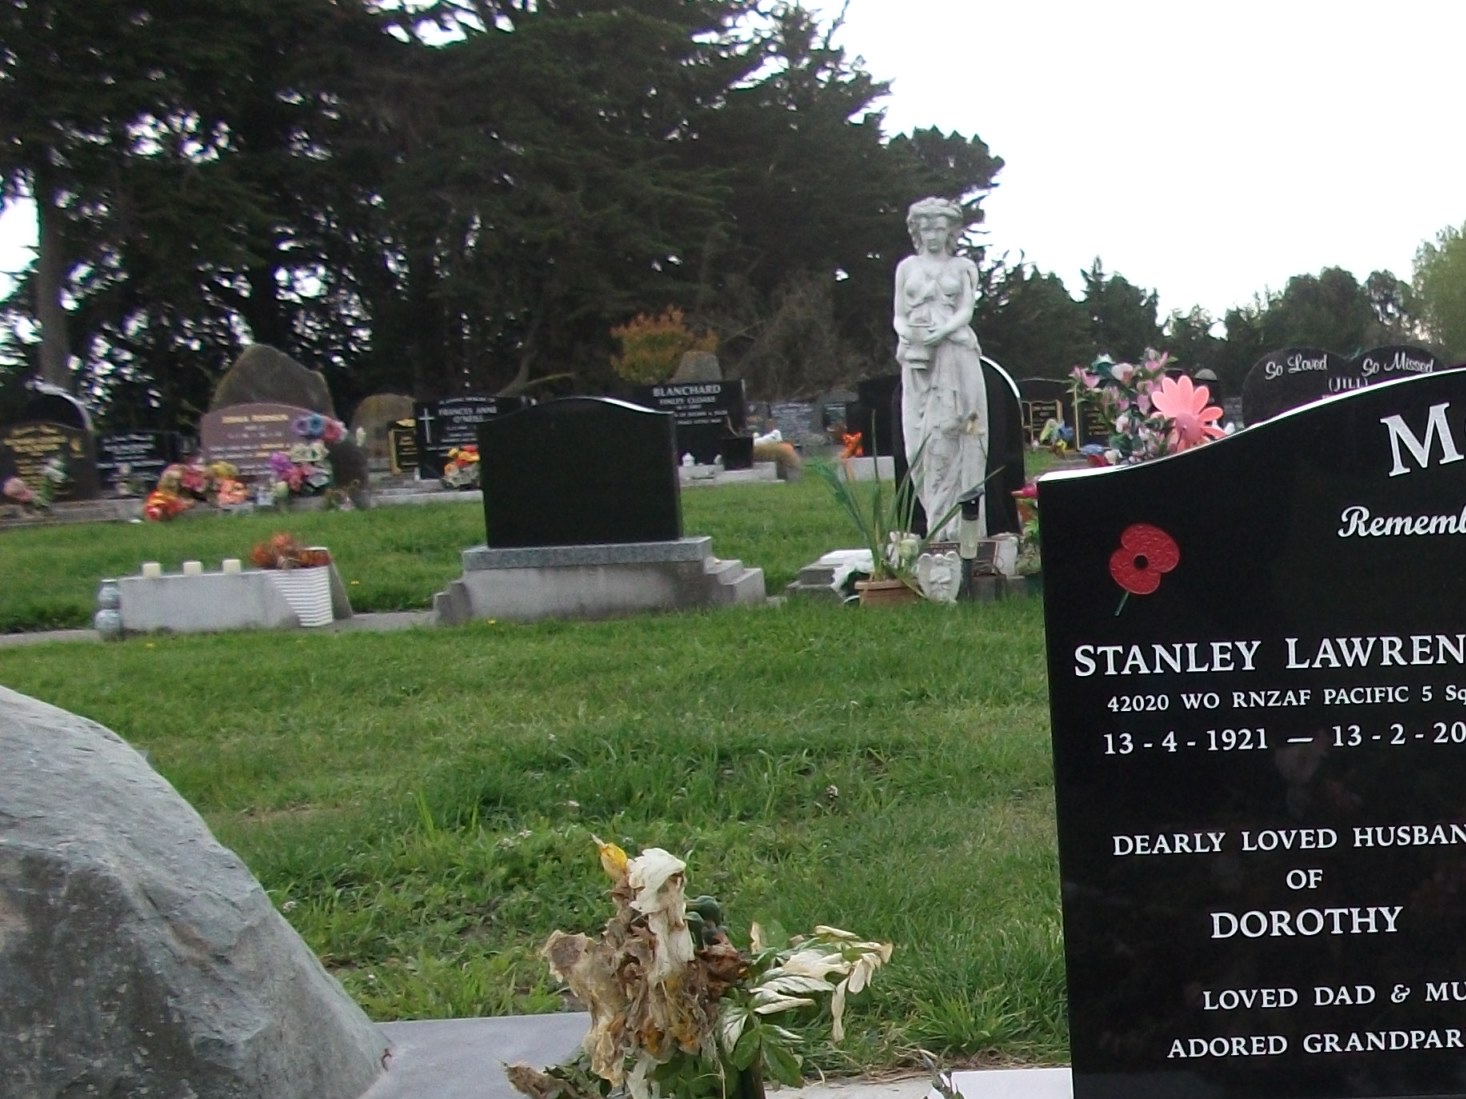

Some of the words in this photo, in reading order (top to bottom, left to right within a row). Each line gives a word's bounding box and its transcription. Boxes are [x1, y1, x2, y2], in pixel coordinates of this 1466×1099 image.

[1264, 361, 1283, 380] So
[1287, 353, 1328, 373] Loved
[1361, 358, 1380, 377] So
[1384, 351, 1434, 373] Missed
[652, 384, 721, 397] BLANCHARD
[1074, 640, 1262, 677] STANLEY
[1107, 694, 1170, 712] 42020
[1180, 692, 1220, 710] WO
[1232, 689, 1311, 708] RNZAF
[1323, 686, 1409, 705] PACIFIC
[1421, 685, 1433, 702] 5
[1112, 832, 1226, 856] DEARLY
[1241, 828, 1338, 851] LOVED
[1286, 869, 1323, 890] OF
[1210, 906, 1404, 939] DOROTHY
[1202, 988, 1298, 1010] LOVED
[1313, 985, 1376, 1006] DAD
[1390, 984, 1411, 1004] &
[1166, 1035, 1288, 1059] ADORED
